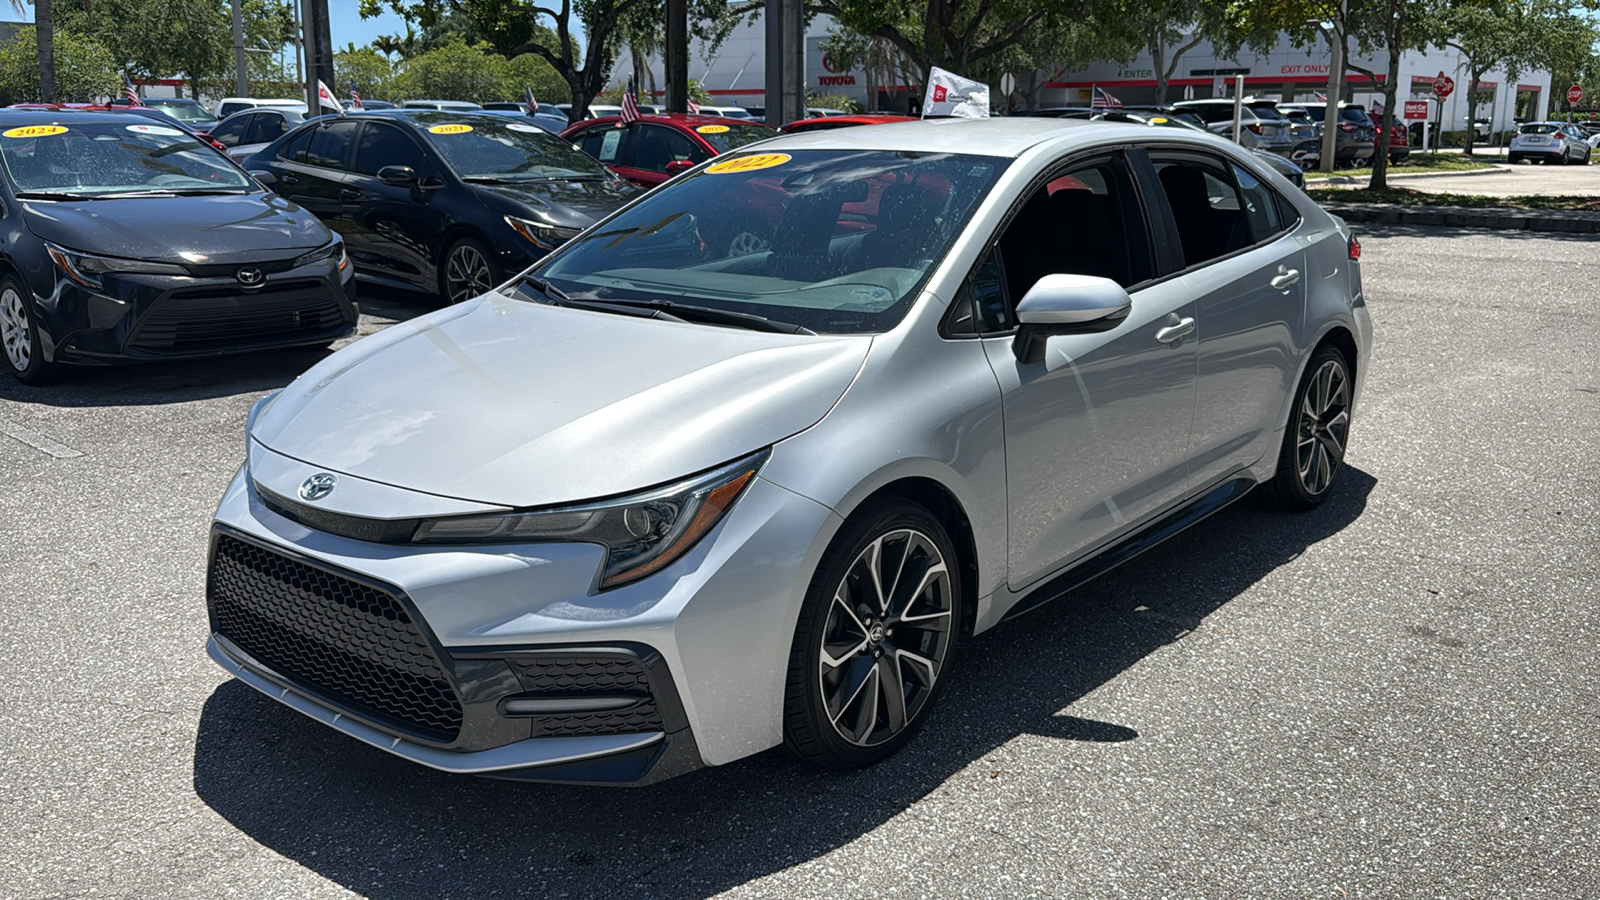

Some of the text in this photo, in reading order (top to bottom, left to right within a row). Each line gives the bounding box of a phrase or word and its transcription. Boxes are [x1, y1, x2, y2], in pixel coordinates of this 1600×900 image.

[1124, 69, 1152, 78] ENTER
[1281, 65, 1330, 74] EXIT ONLY
[818, 75, 856, 86] TOYOTA
[1568, 90, 1582, 99] STOP
[16, 126, 57, 137] 2024
[713, 155, 780, 172] 2022
